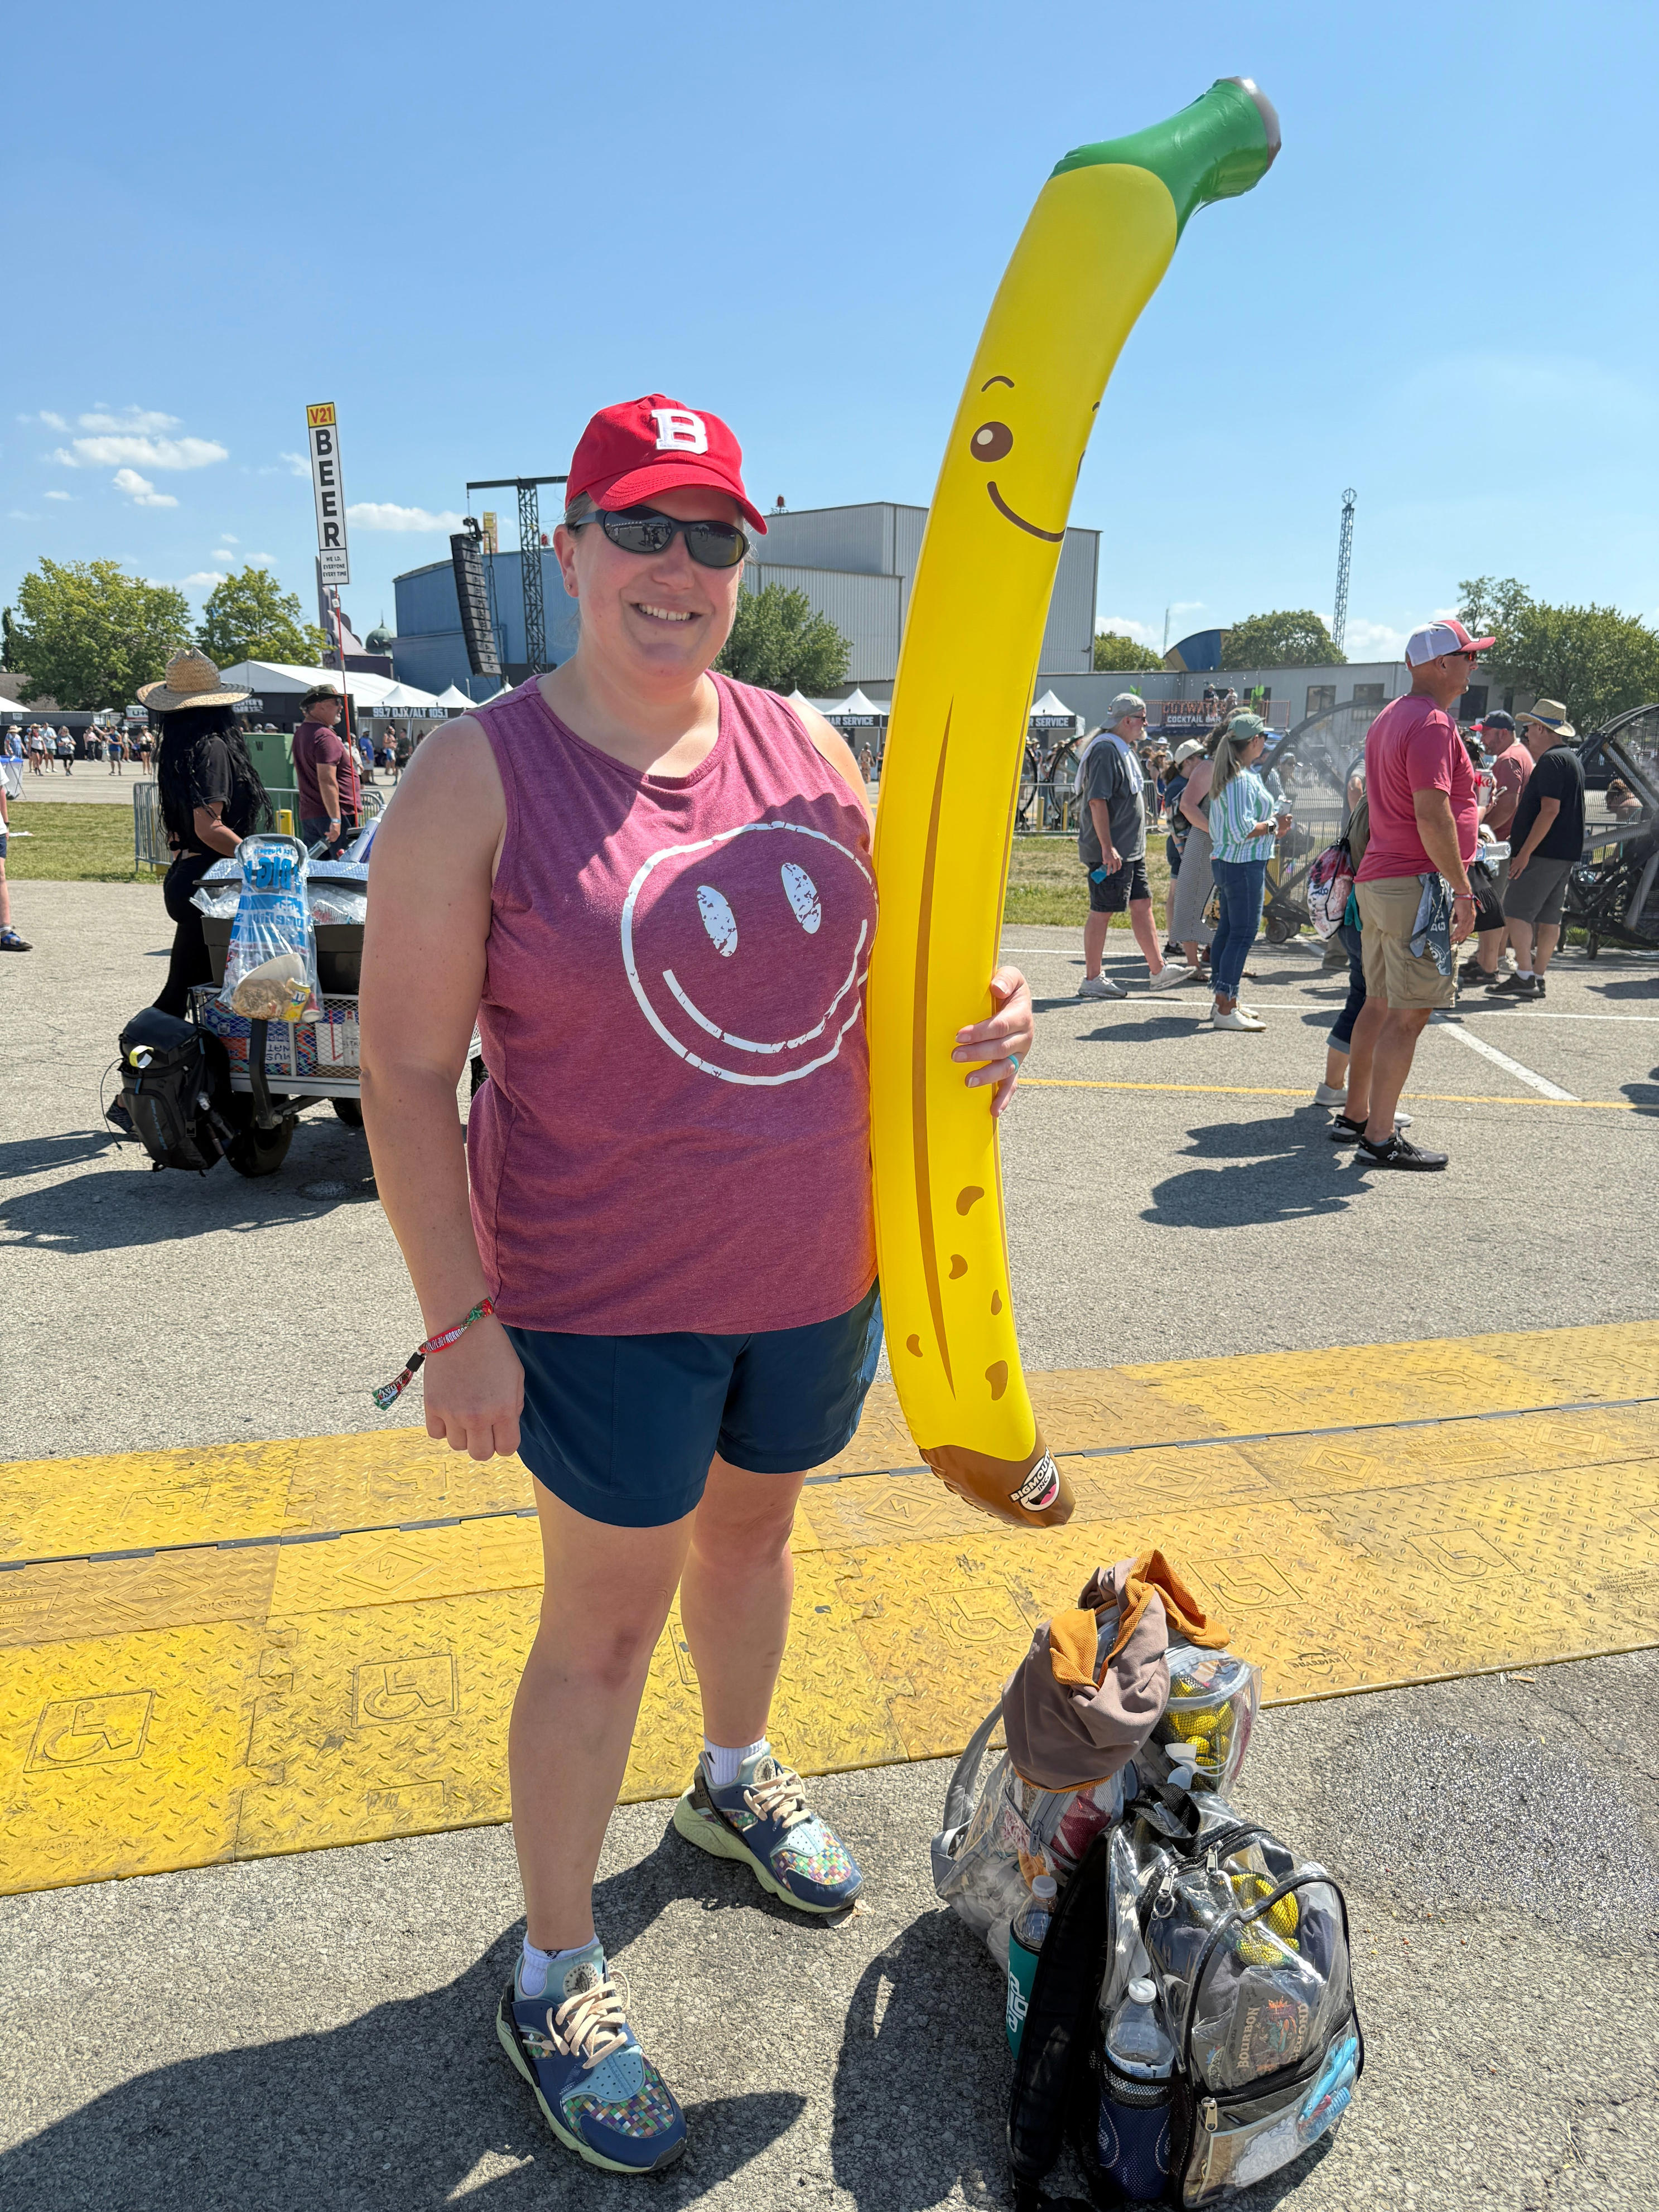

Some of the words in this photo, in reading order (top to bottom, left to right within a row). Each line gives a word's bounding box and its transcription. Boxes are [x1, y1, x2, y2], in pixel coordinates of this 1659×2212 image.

[310, 406, 332, 424] V21
[651, 408, 708, 455] B
[315, 429, 341, 547] BEER
[373, 707, 390, 718] 99.7
[392, 708, 427, 718] DJX/ALT
[429, 708, 448, 718] 105.1
[1205, 714, 1221, 723] BAR
[842, 716, 874, 726] SERVICE
[1035, 717, 1069, 727] SERVICE
[1038, 1476, 1049, 1491] INC.
[1236, 2007, 1261, 2069] BOURBON
